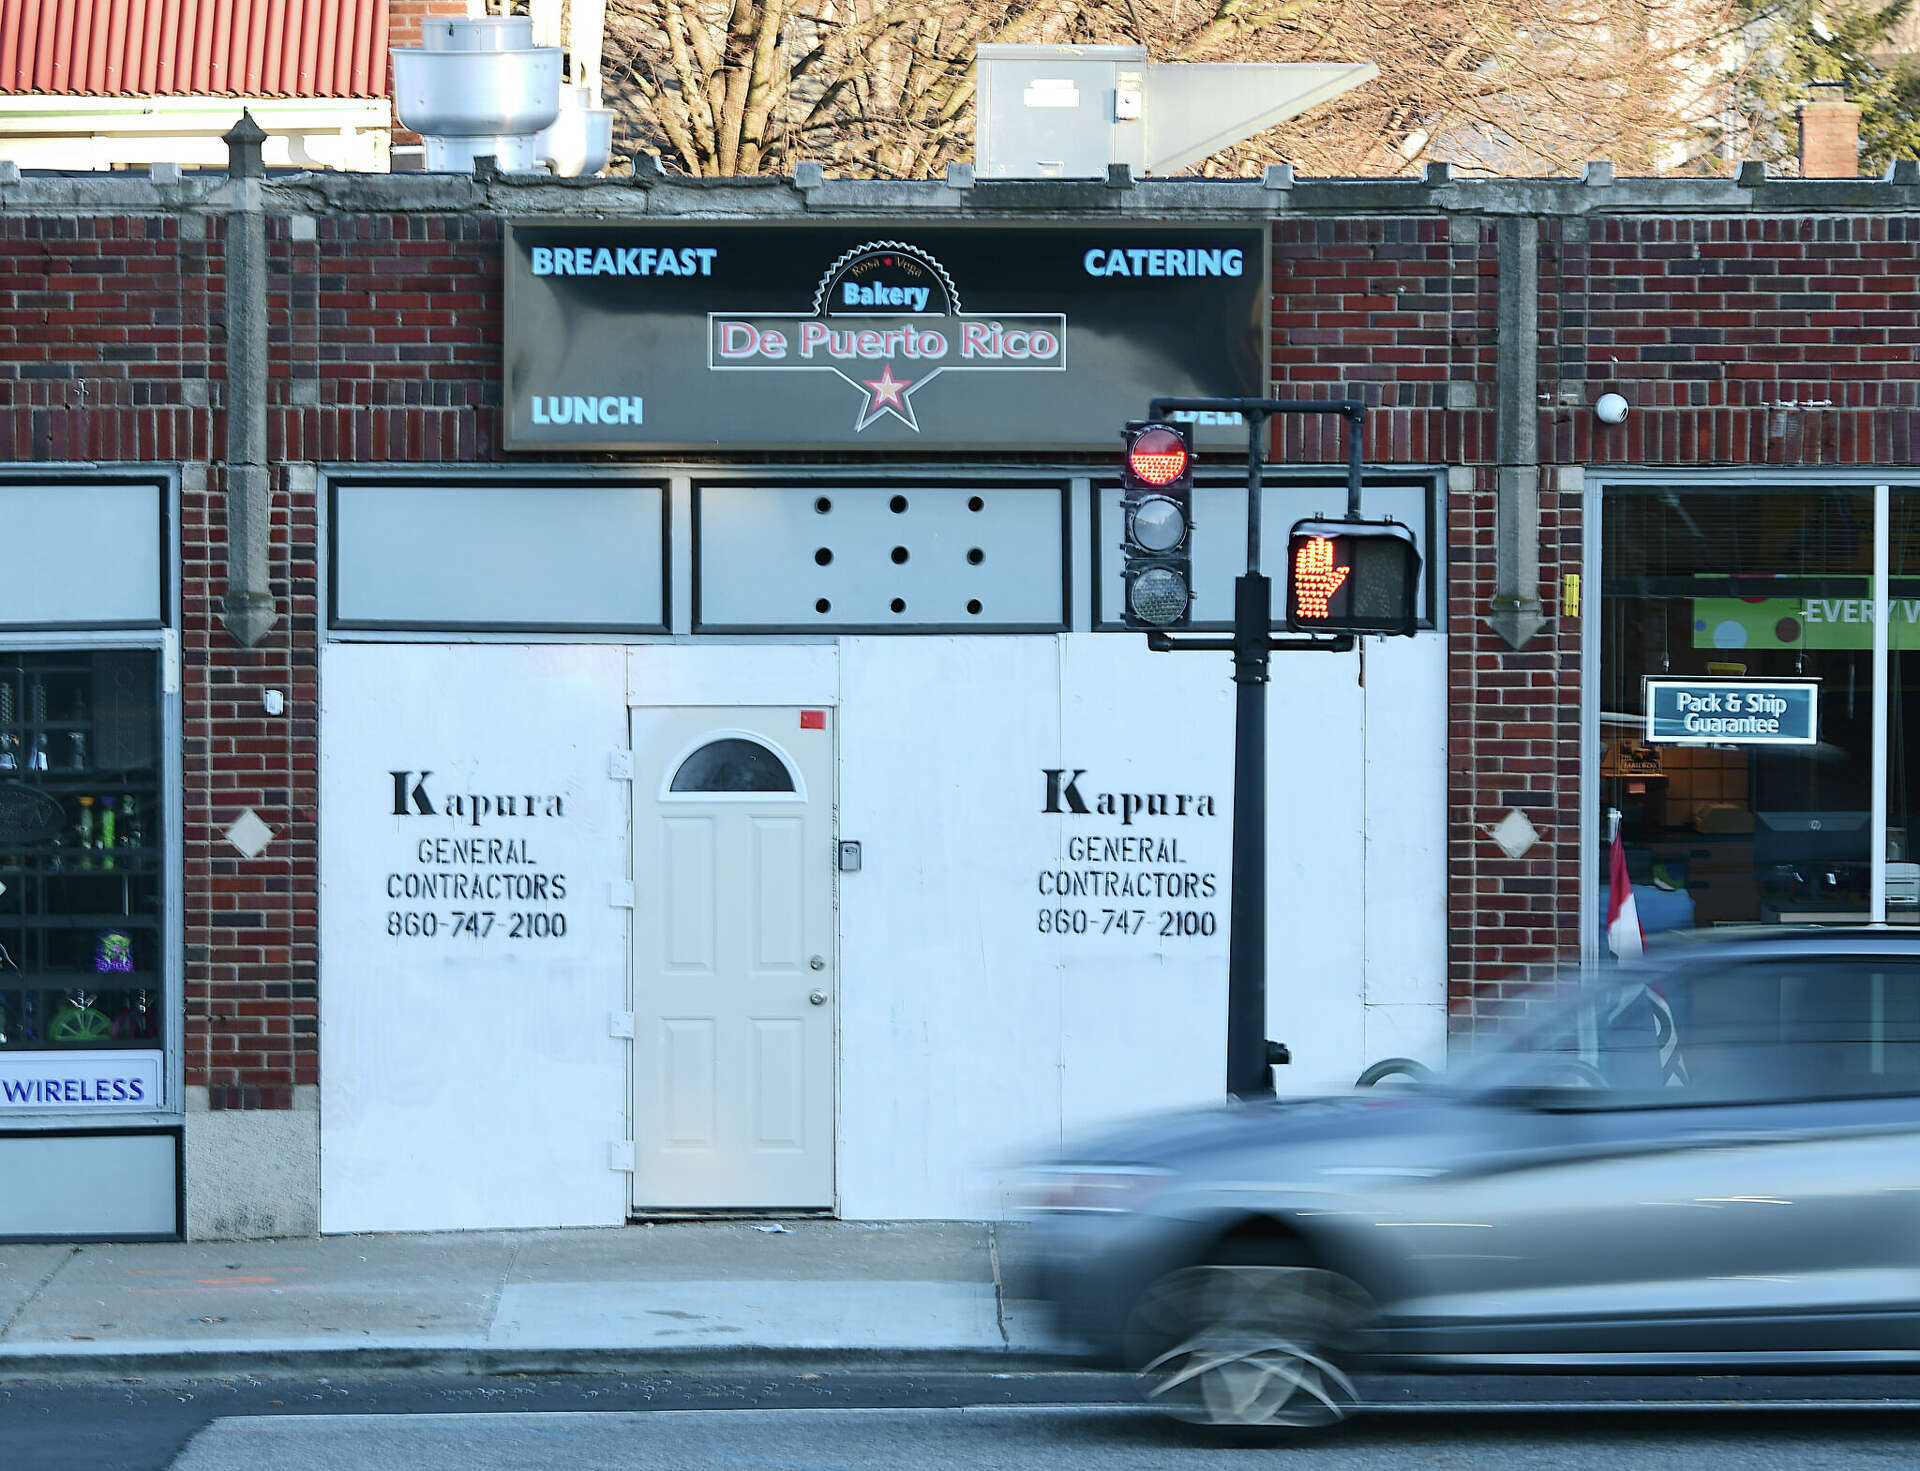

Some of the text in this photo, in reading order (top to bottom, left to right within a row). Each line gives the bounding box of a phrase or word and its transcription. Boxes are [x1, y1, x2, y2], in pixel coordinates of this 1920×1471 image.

[532, 247, 717, 276] BREAKFAST
[851, 256, 922, 278] Rosa Vega
[1084, 248, 1243, 277] CATERING
[843, 281, 930, 312] Bakery
[719, 321, 1059, 359] De Puerto Rico
[532, 396, 643, 424] LUNCH
[1676, 692, 1788, 717] Pack & Ship
[1684, 713, 1780, 733] Guarantee
[388, 770, 564, 826] Kapura
[1041, 769, 1216, 825] Kapura
[418, 838, 537, 864] GENERAL
[1069, 836, 1187, 863] GENERAL
[387, 873, 567, 900] CONTRACTORS
[1038, 871, 1217, 898] CONTRACTORS
[387, 911, 567, 938] 860-747-2100
[1038, 908, 1217, 936] 860-747-2100
[2, 1077, 145, 1103] WIRELESS
